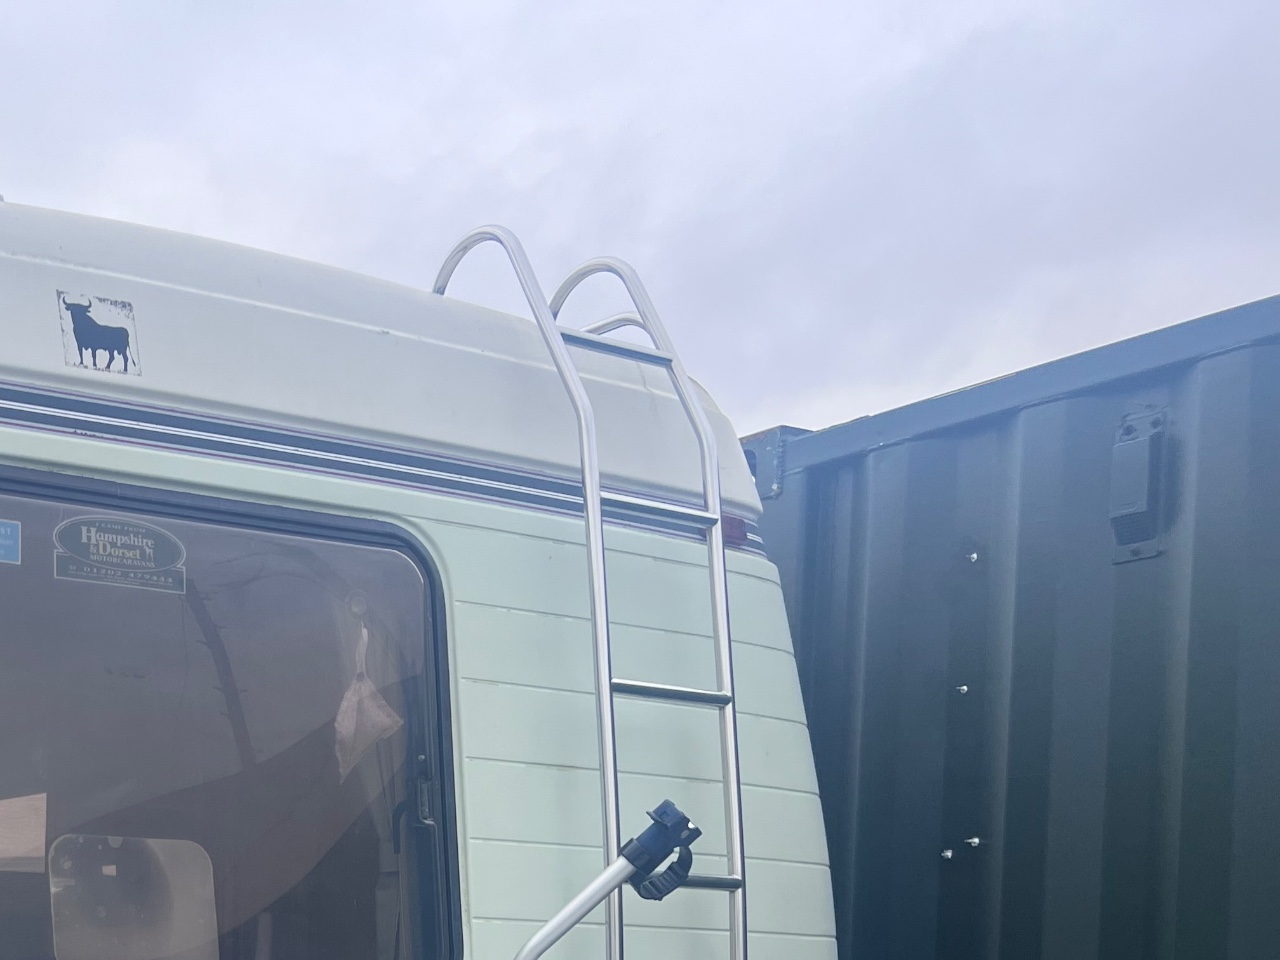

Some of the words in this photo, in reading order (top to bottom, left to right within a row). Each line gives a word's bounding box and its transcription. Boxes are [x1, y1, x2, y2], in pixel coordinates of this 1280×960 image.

[80, 525, 155, 548] Hampshire
[90, 544, 98, 554] &
[98, 540, 141, 560] Dorset
[90, 554, 156, 568] MOTORCARAVANS
